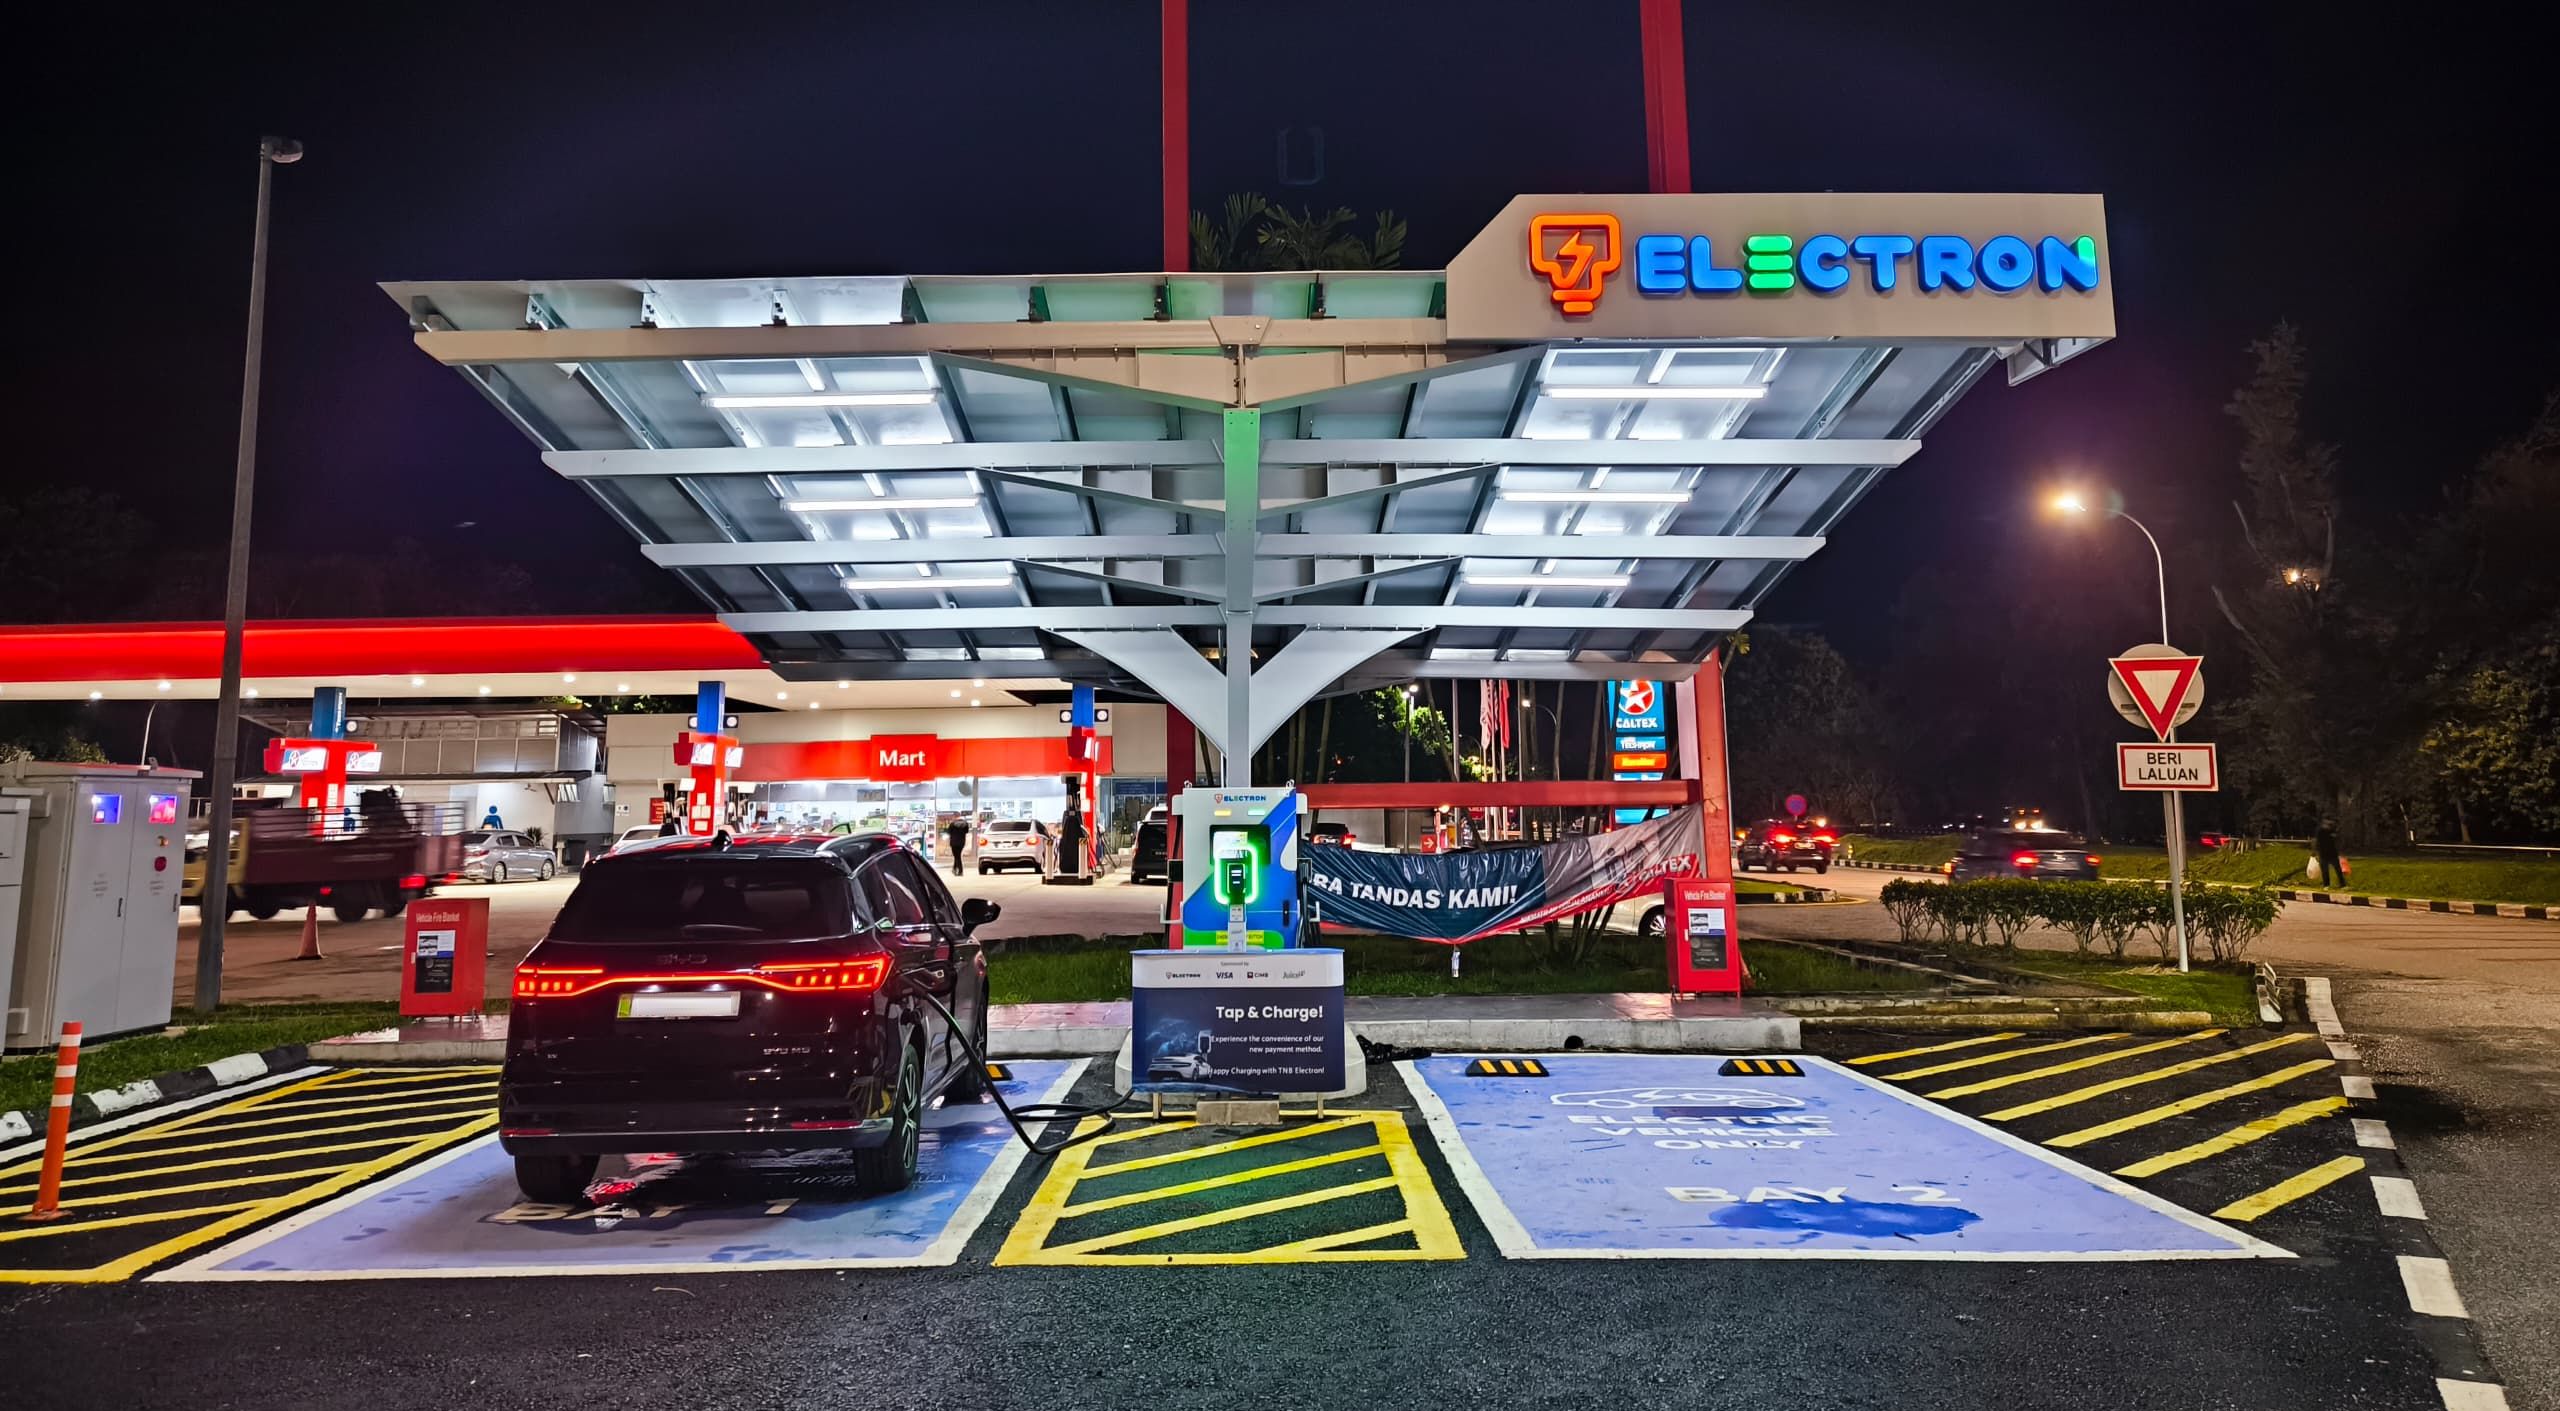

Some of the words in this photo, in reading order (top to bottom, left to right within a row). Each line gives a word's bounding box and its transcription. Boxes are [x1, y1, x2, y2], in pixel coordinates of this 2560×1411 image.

[1635, 234, 2098, 293] ELECTRON
[1615, 717, 1658, 729] CALTEX
[879, 749, 926, 767] Mart
[2147, 752, 2181, 765] BERI
[2138, 768, 2199, 781] LALUAN
[1311, 873, 1343, 895] RA
[1350, 881, 1440, 909] TANDAS
[1448, 885, 1518, 909] KAMI!
[1216, 1006, 1245, 1022] Tap
[1248, 1006, 1259, 1018] &
[1262, 1005, 1323, 1022] Charge!
[1211, 1035, 1247, 1043] Experience
[1249, 1034, 1260, 1042] the
[1304, 1034, 1311, 1042] of
[1265, 1046, 1293, 1054] payment
[1208, 1066, 1229, 1076] Happy
[1231, 1066, 1261, 1076] Charging
[1262, 1066, 1277, 1074] with
[1295, 1066, 1324, 1074] Electron!
[1568, 1115, 1832, 1124] ELECTRIC
[1591, 1127, 1839, 1136] VEHICLE
[1653, 1140, 1804, 1149] ONLY
[1664, 1186, 1849, 1203] BAY
[1890, 1186, 1961, 1202] 2
